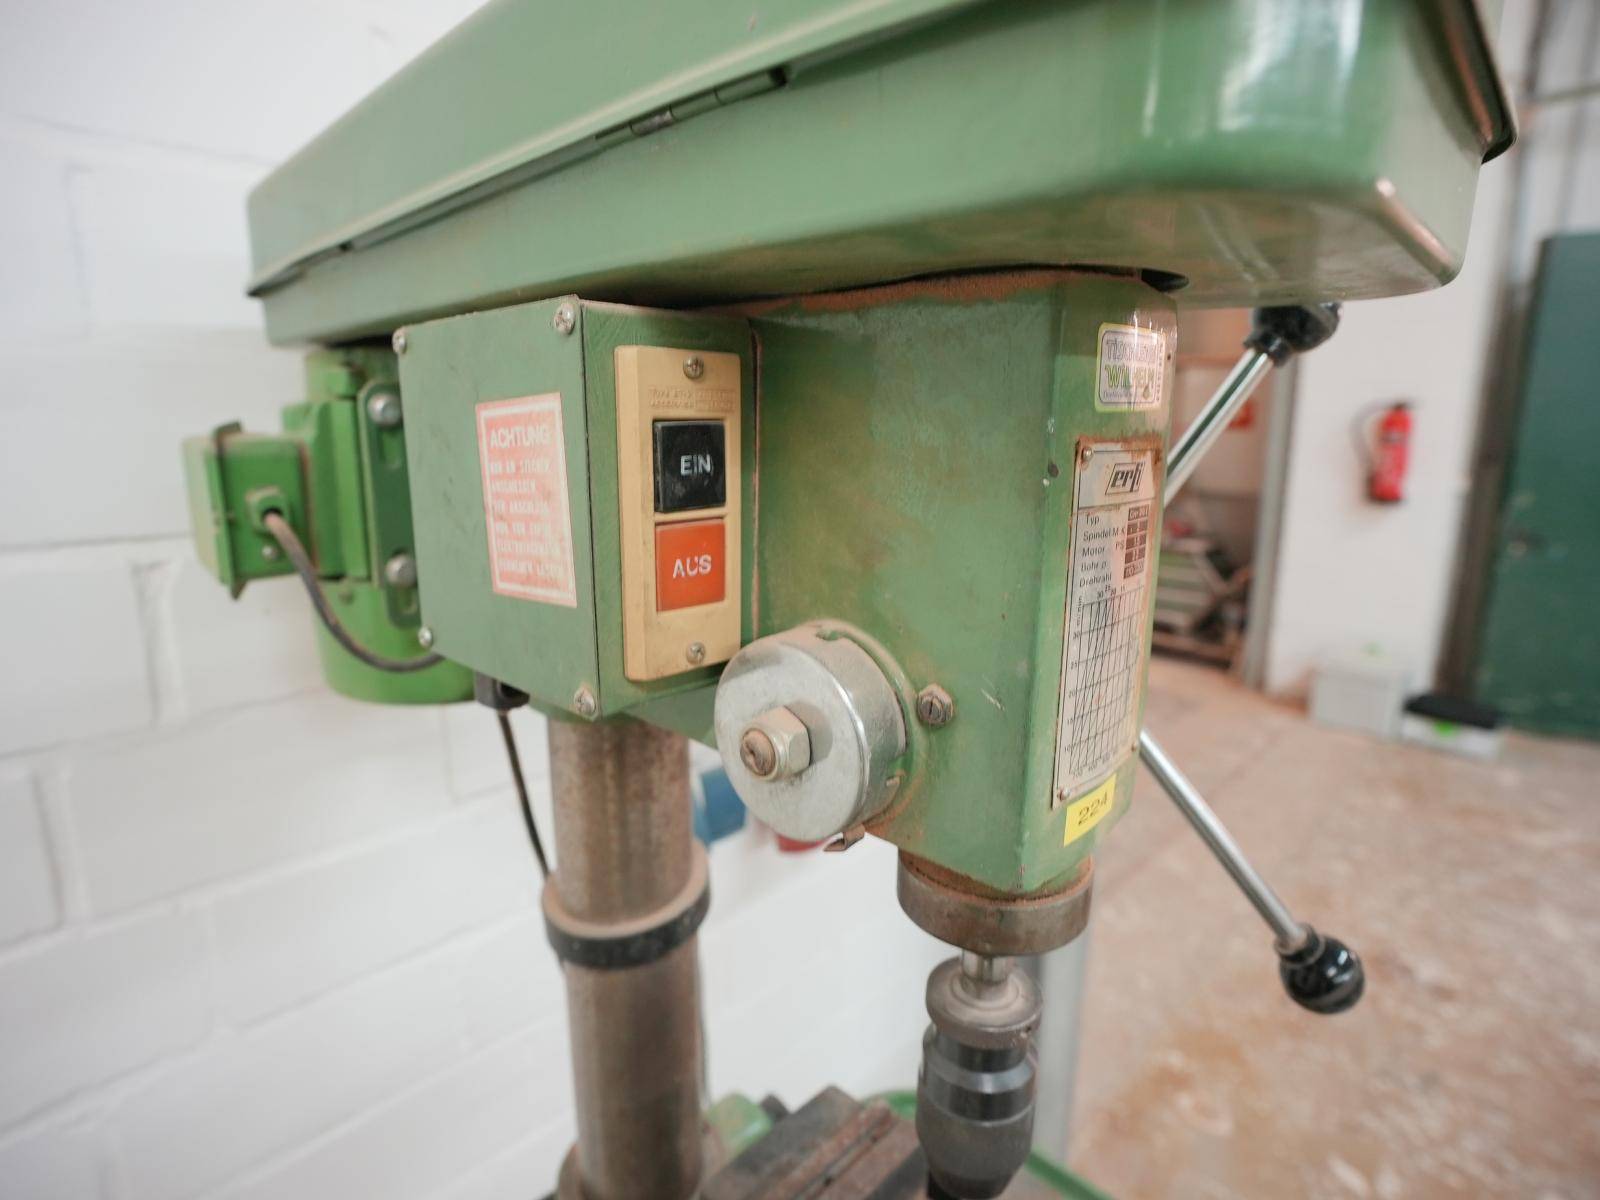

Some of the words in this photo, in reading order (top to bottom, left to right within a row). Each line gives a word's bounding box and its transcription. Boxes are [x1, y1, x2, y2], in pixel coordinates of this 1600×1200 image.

[489, 424, 552, 449] ACHTUNG
[680, 453, 712, 477] EIN
[1085, 513, 1100, 526] Typ
[1083, 527, 1111, 542] Spindel
[1082, 546, 1105, 557] Motor
[672, 553, 712, 579] AUS
[1079, 572, 1112, 588] Drehzahl
[1078, 788, 1108, 826] 224
